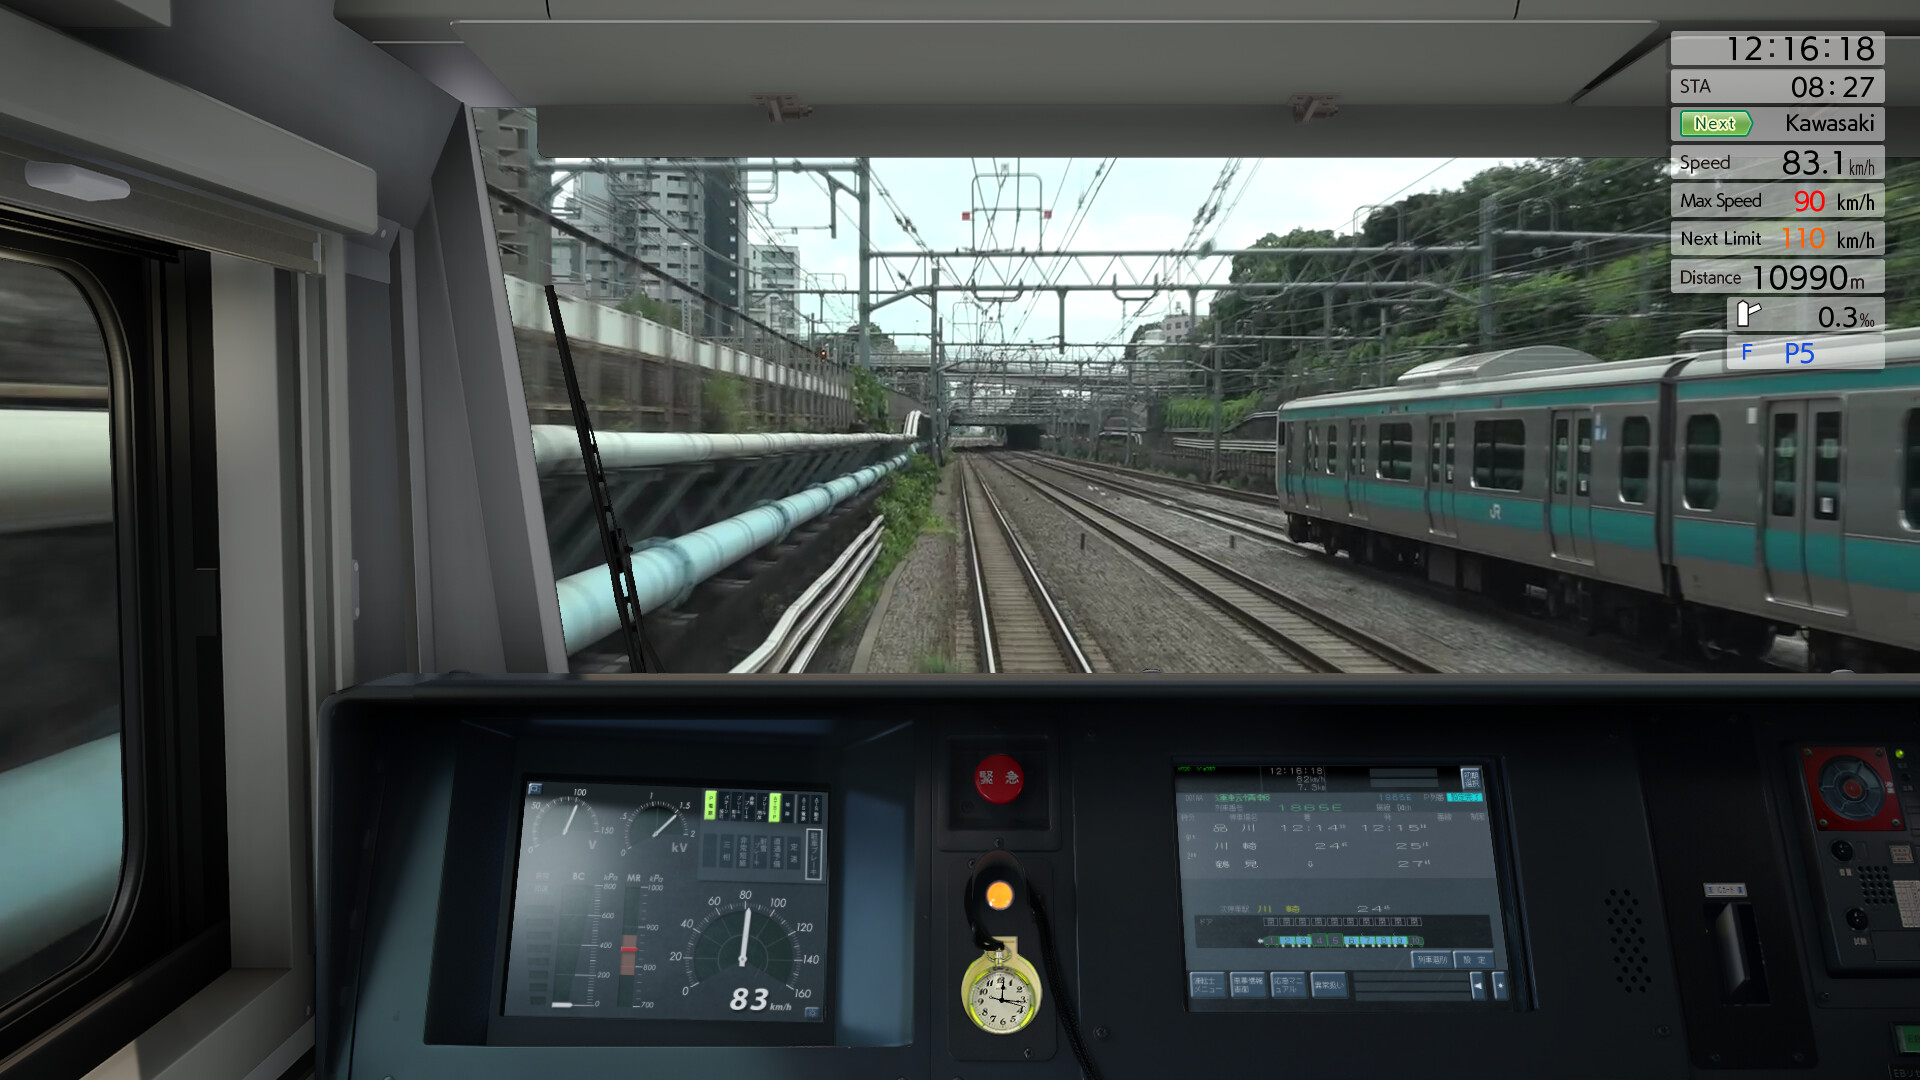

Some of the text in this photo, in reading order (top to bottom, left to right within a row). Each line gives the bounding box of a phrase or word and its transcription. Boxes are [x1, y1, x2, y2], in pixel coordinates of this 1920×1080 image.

[1489, 503, 1502, 520] JR
[1269, 767, 1323, 775] 12:16:18
[979, 770, 1019, 785] 緊急
[573, 788, 587, 797] 100
[530, 801, 541, 810] 50
[600, 826, 614, 835] 150
[588, 840, 597, 850] V
[671, 842, 688, 853] kV
[572, 872, 586, 881] BC
[626, 874, 641, 882] MR
[649, 873, 664, 883] kPa
[739, 890, 752, 900] 80
[708, 896, 721, 906] 60
[770, 898, 787, 908] 100
[680, 918, 694, 929] 40
[796, 922, 813, 932] 120
[669, 951, 682, 961] 20
[802, 954, 820, 964] 140
[682, 986, 689, 996] 0
[794, 988, 811, 998] 160
[979, 988, 988, 996] 10
[729, 987, 792, 1011] 83 km/h
[981, 1008, 988, 1016] 8
[990, 1015, 996, 1023] 7
[1000, 1018, 1006, 1026] 6
[1010, 1015, 1016, 1023] 5
